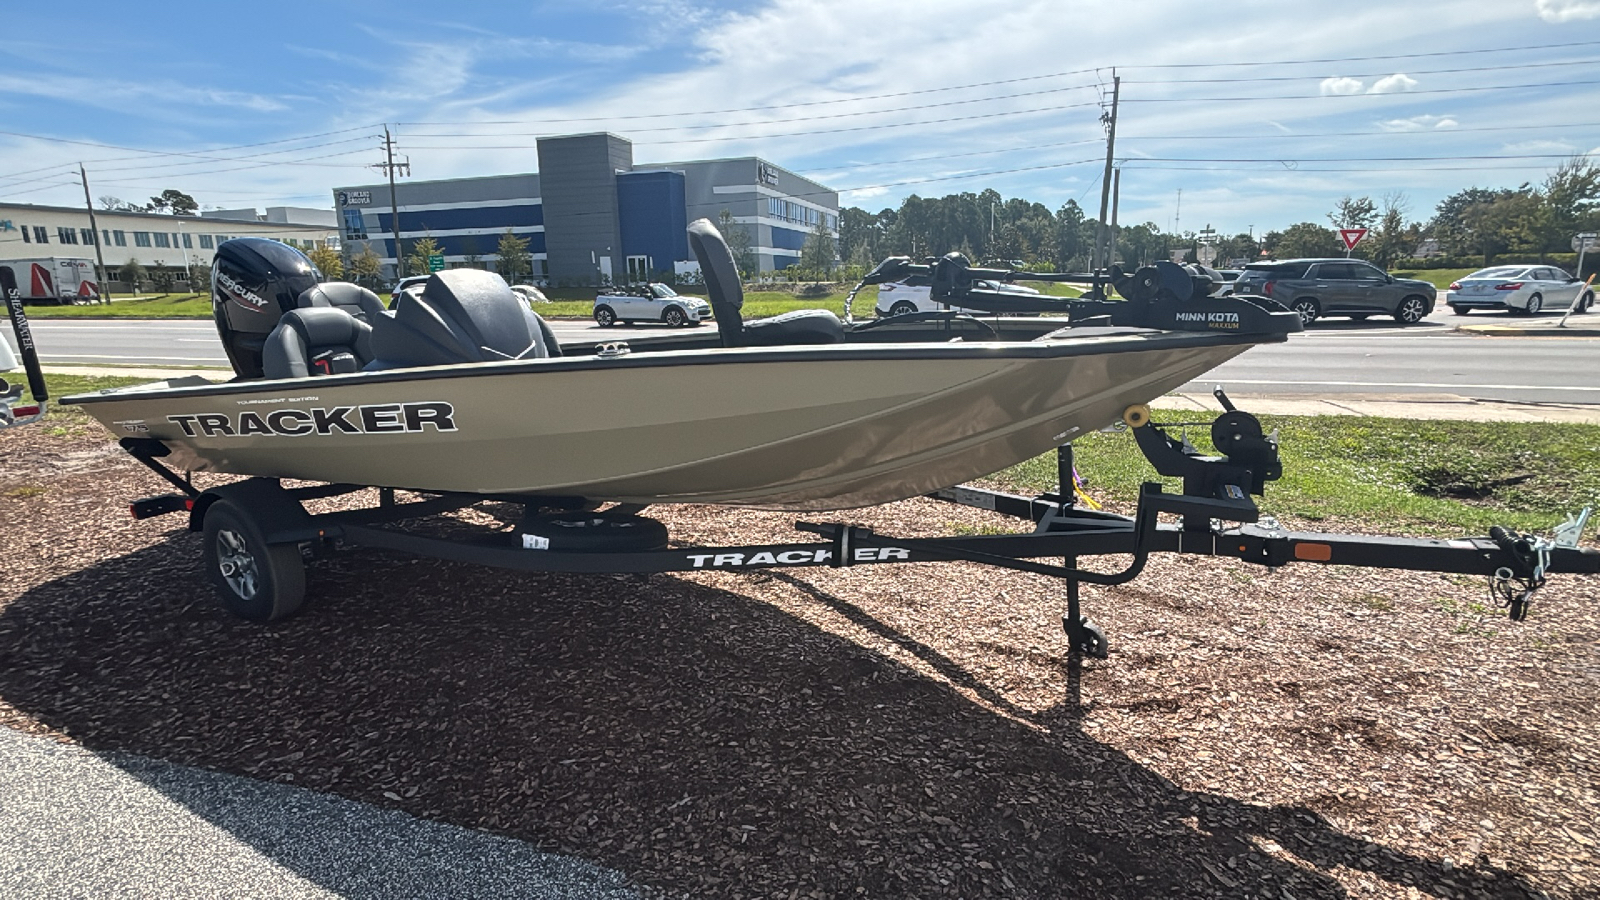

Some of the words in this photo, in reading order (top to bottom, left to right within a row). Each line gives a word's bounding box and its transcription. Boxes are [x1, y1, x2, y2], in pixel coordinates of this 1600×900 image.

[216, 271, 269, 307] MERCURY
[8, 288, 33, 350] SHEARWATER
[1176, 313, 1206, 321] MINN
[1207, 313, 1239, 322] KOTA
[167, 401, 458, 437] TRACKER
